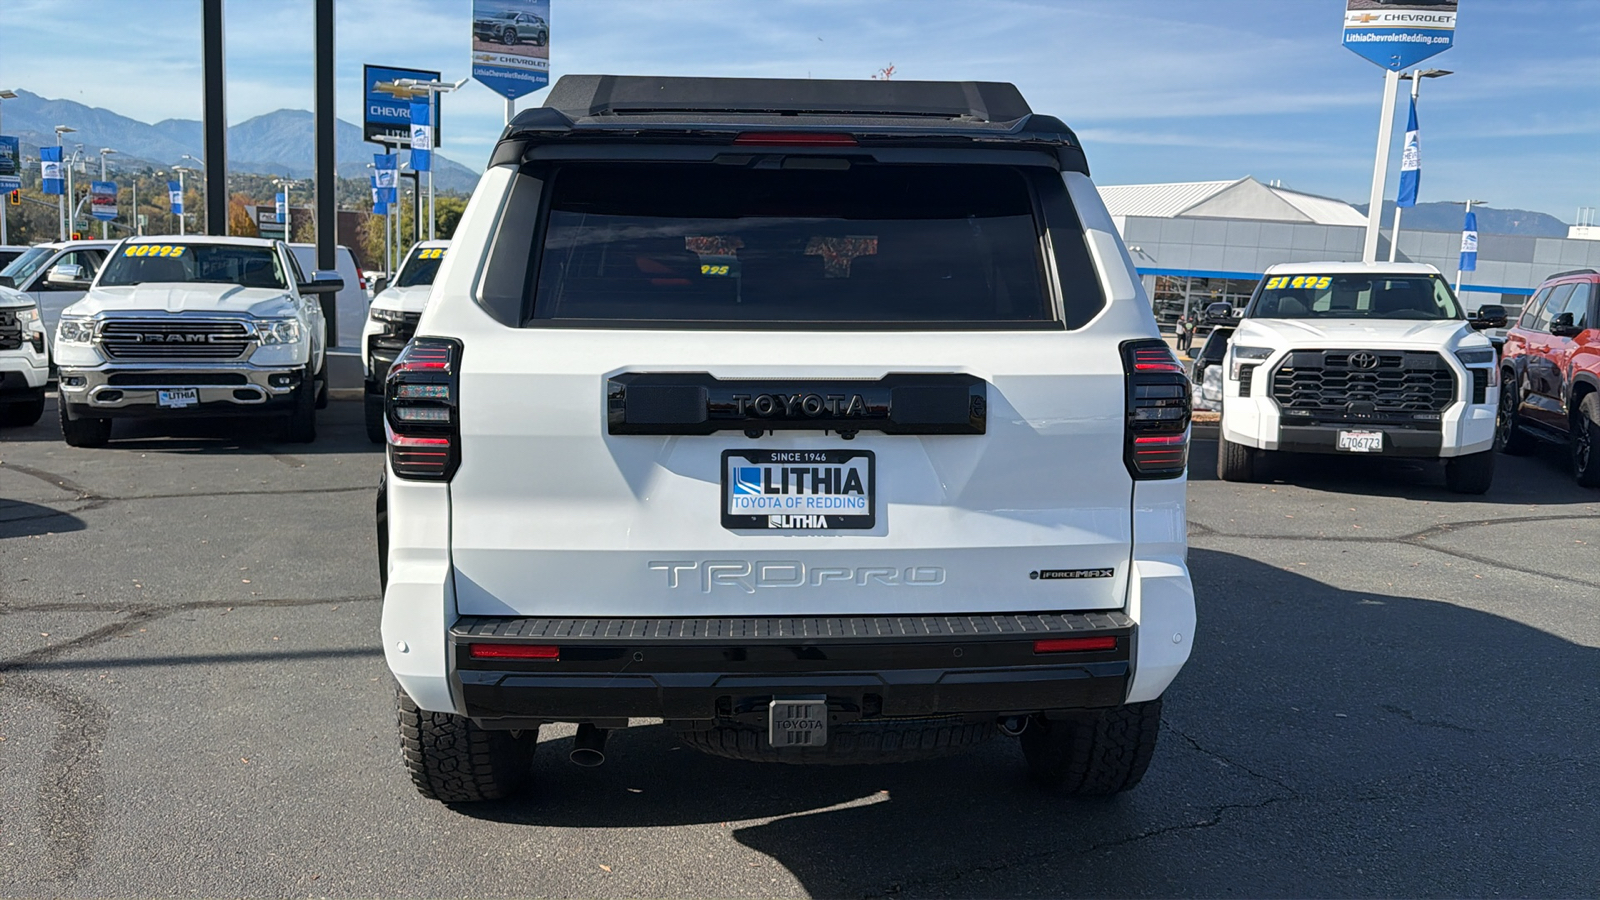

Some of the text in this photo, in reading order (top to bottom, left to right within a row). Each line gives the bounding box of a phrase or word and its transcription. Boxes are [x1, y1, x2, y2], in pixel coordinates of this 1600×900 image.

[1384, 14, 1452, 23] CHEVROLET
[1346, 33, 1449, 44] LithiaChevroletRedding.com
[500, 57, 547, 68] CHEVROLET
[474, 68, 547, 83] LithiaChevroletRedding.com
[123, 245, 186, 257] 40995
[145, 334, 206, 342] RAM
[169, 391, 195, 400] LITHIA
[733, 394, 869, 417] TOYOTA
[771, 453, 827, 461] SINCE 1946
[764, 467, 865, 495] LITHIA
[734, 497, 865, 509] TOYOTA OF REDDING
[782, 515, 828, 528] LITHIA
[776, 720, 823, 729] TOYOTA
